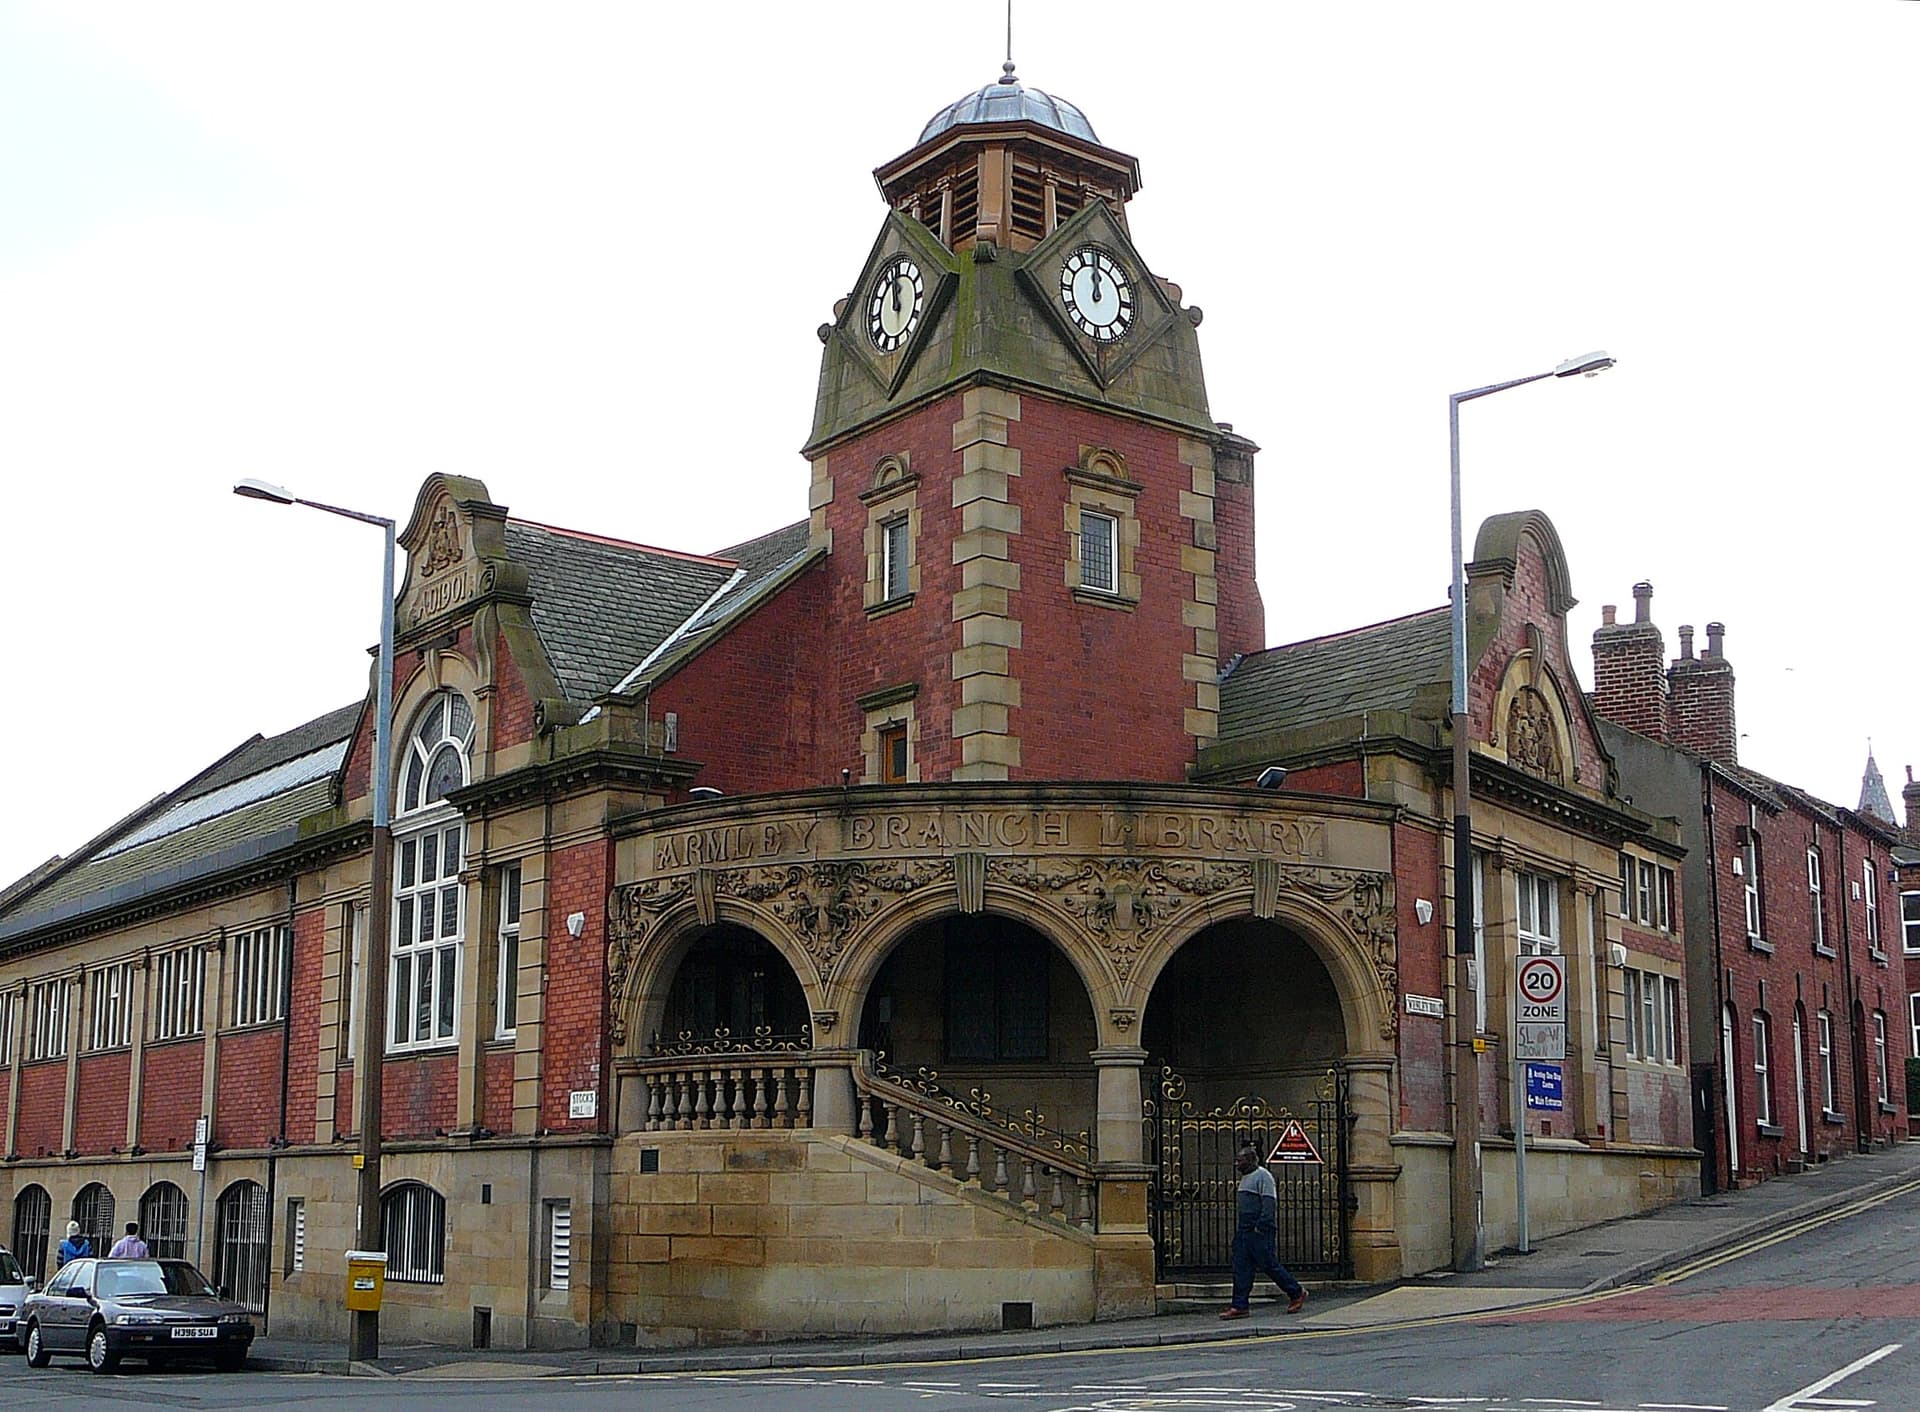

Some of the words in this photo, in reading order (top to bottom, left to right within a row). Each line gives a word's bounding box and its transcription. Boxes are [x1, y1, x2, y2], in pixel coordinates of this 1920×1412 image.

[656, 819, 820, 870] ARMLEY
[842, 811, 1071, 851] BRANCH
[1527, 972, 1554, 990] 20
[1523, 1006, 1558, 1017] ZONE
[572, 1093, 594, 1104] STOCKS
